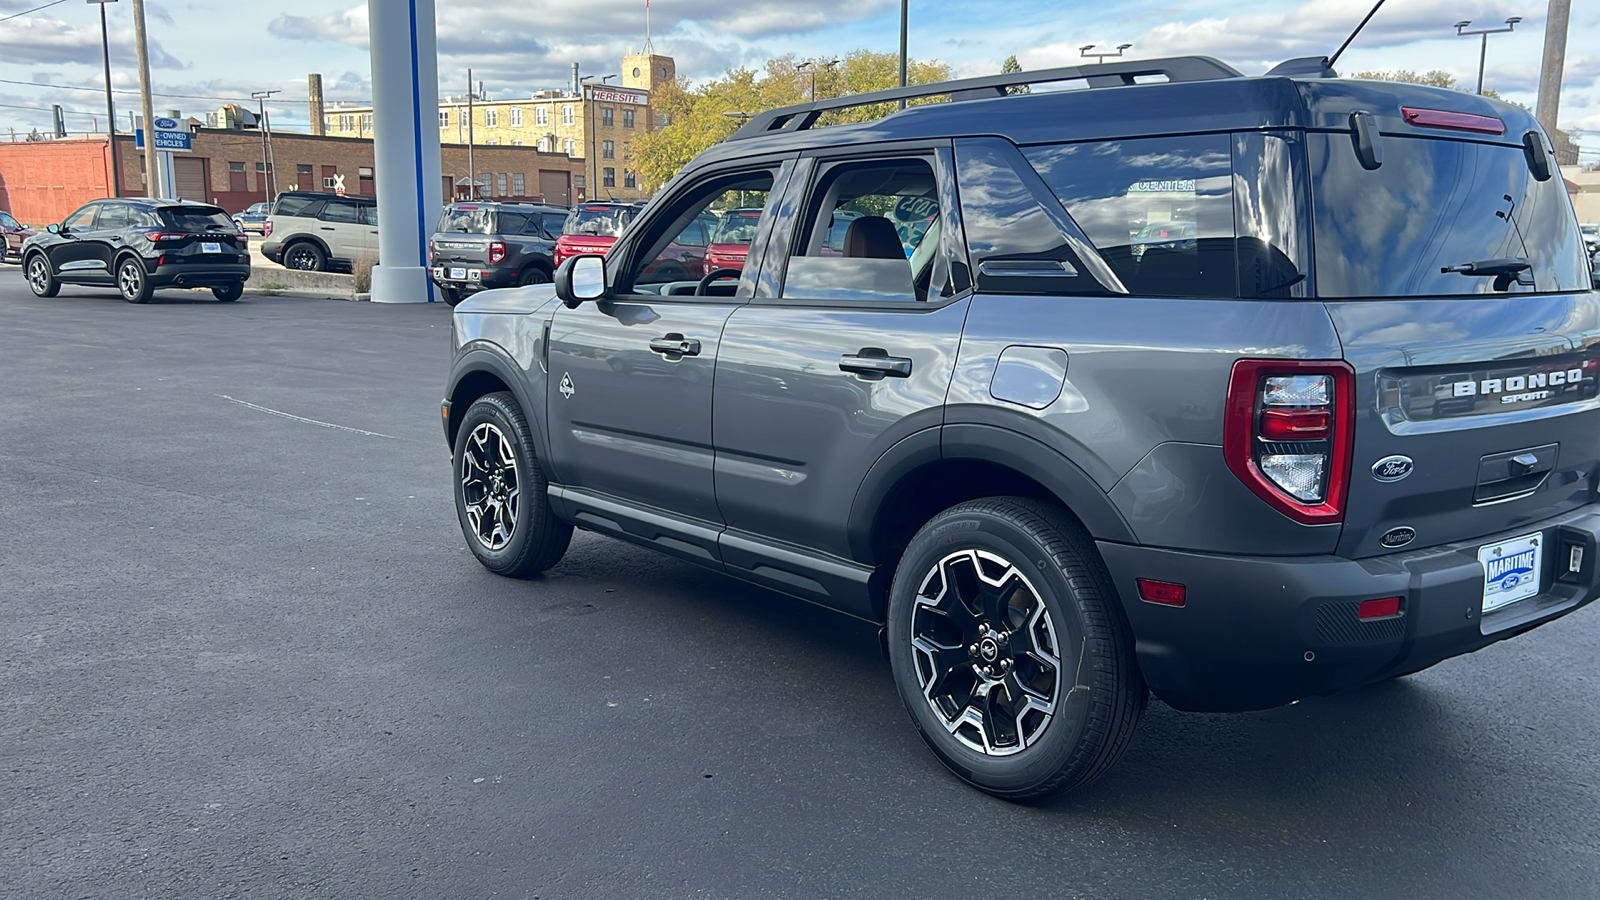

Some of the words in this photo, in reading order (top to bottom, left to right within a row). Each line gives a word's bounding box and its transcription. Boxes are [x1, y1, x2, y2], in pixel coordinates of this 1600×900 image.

[593, 91, 639, 103] HERESITE
[155, 132, 187, 140] E-OWNED
[1138, 179, 1195, 192] CENTER
[1453, 368, 1582, 397] BRONCO
[1501, 391, 1549, 404] SPORT
[1382, 461, 1407, 476] Ford
[1384, 531, 1413, 544] Maritime
[1487, 551, 1534, 582] MARITIME
